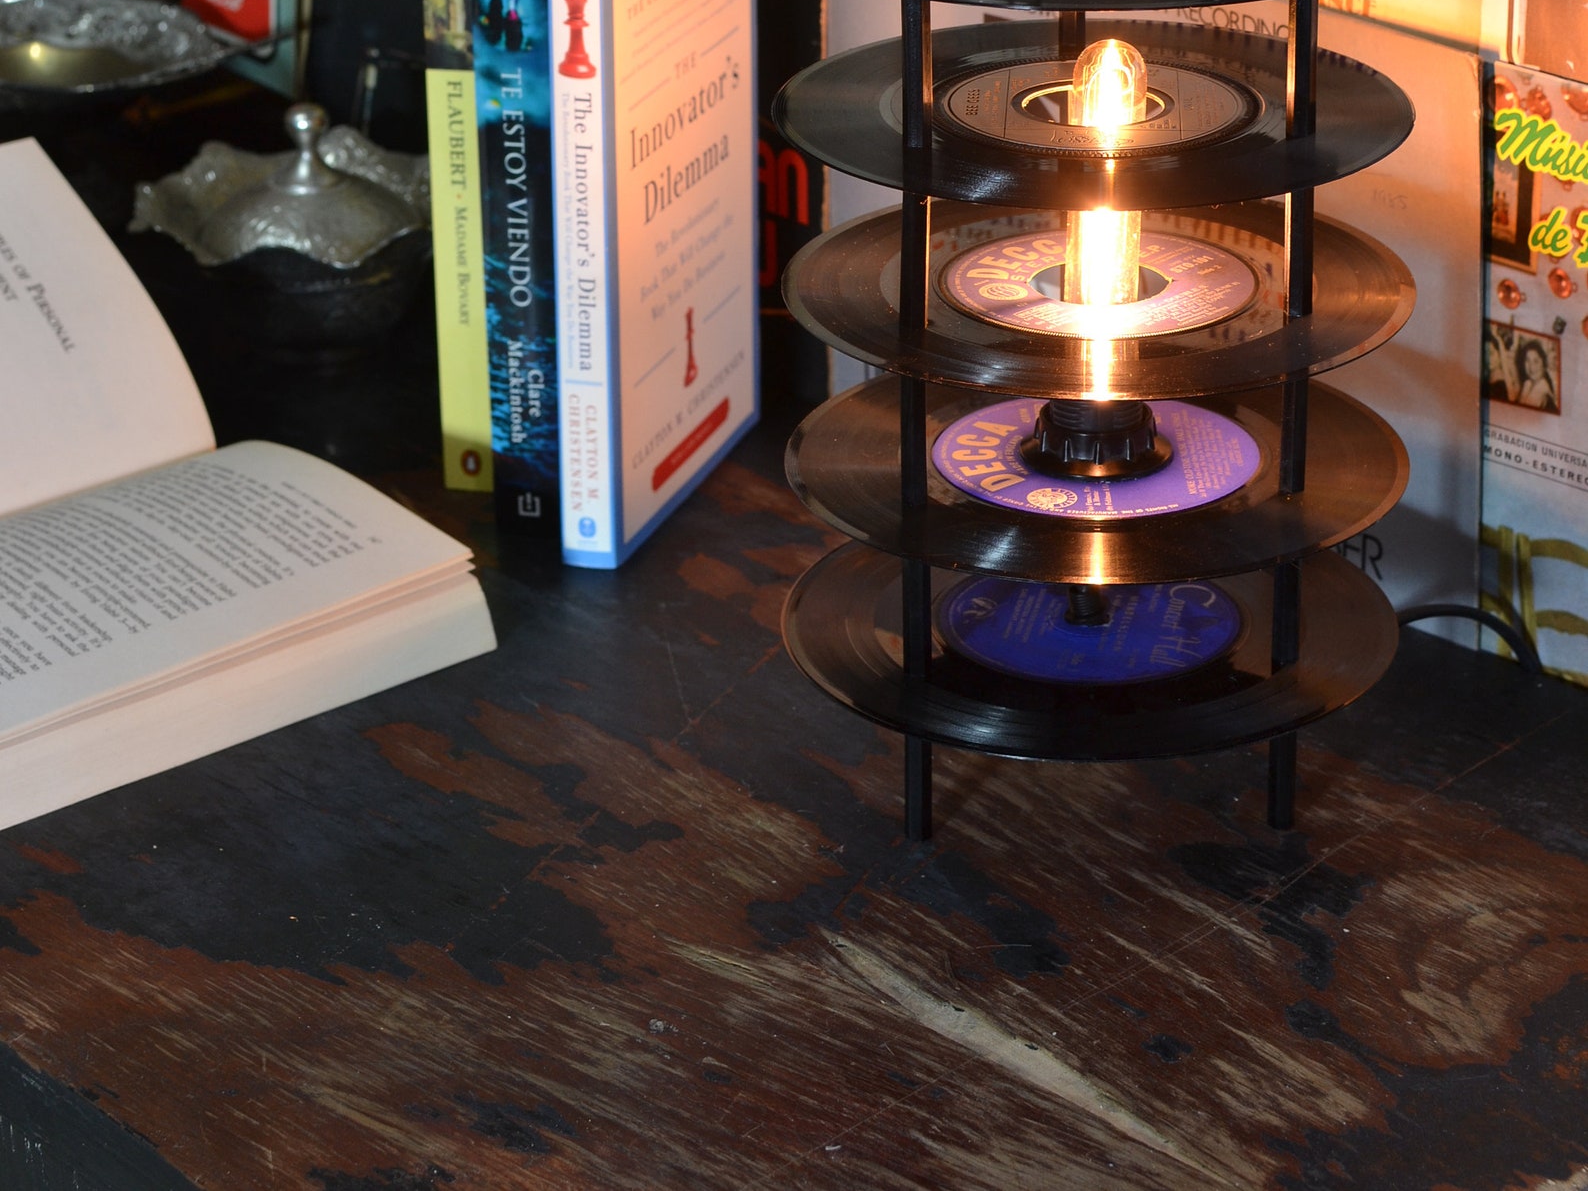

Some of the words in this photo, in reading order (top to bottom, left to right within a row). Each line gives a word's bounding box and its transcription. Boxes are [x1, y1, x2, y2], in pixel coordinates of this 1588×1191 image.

[500, 67, 523, 99] TE
[573, 92, 593, 135] The
[630, 55, 741, 171] Innovator's
[446, 80, 467, 190] FLAUBERT
[502, 109, 528, 191] ESTOY
[574, 142, 596, 269] Innovator's
[644, 134, 730, 226] Dilemma
[506, 197, 533, 308] VIENDO
[966, 239, 1067, 280] DECC
[1530, 208, 1570, 255] de
[1010, 257, 1067, 282] STER
[577, 275, 598, 372] Dilemma
[507, 339, 528, 444] Mackintosh
[527, 368, 545, 418] Clare
[951, 420, 1026, 492] DECCA
[1160, 584, 1217, 633] Concert
[1149, 636, 1203, 668] Hall
